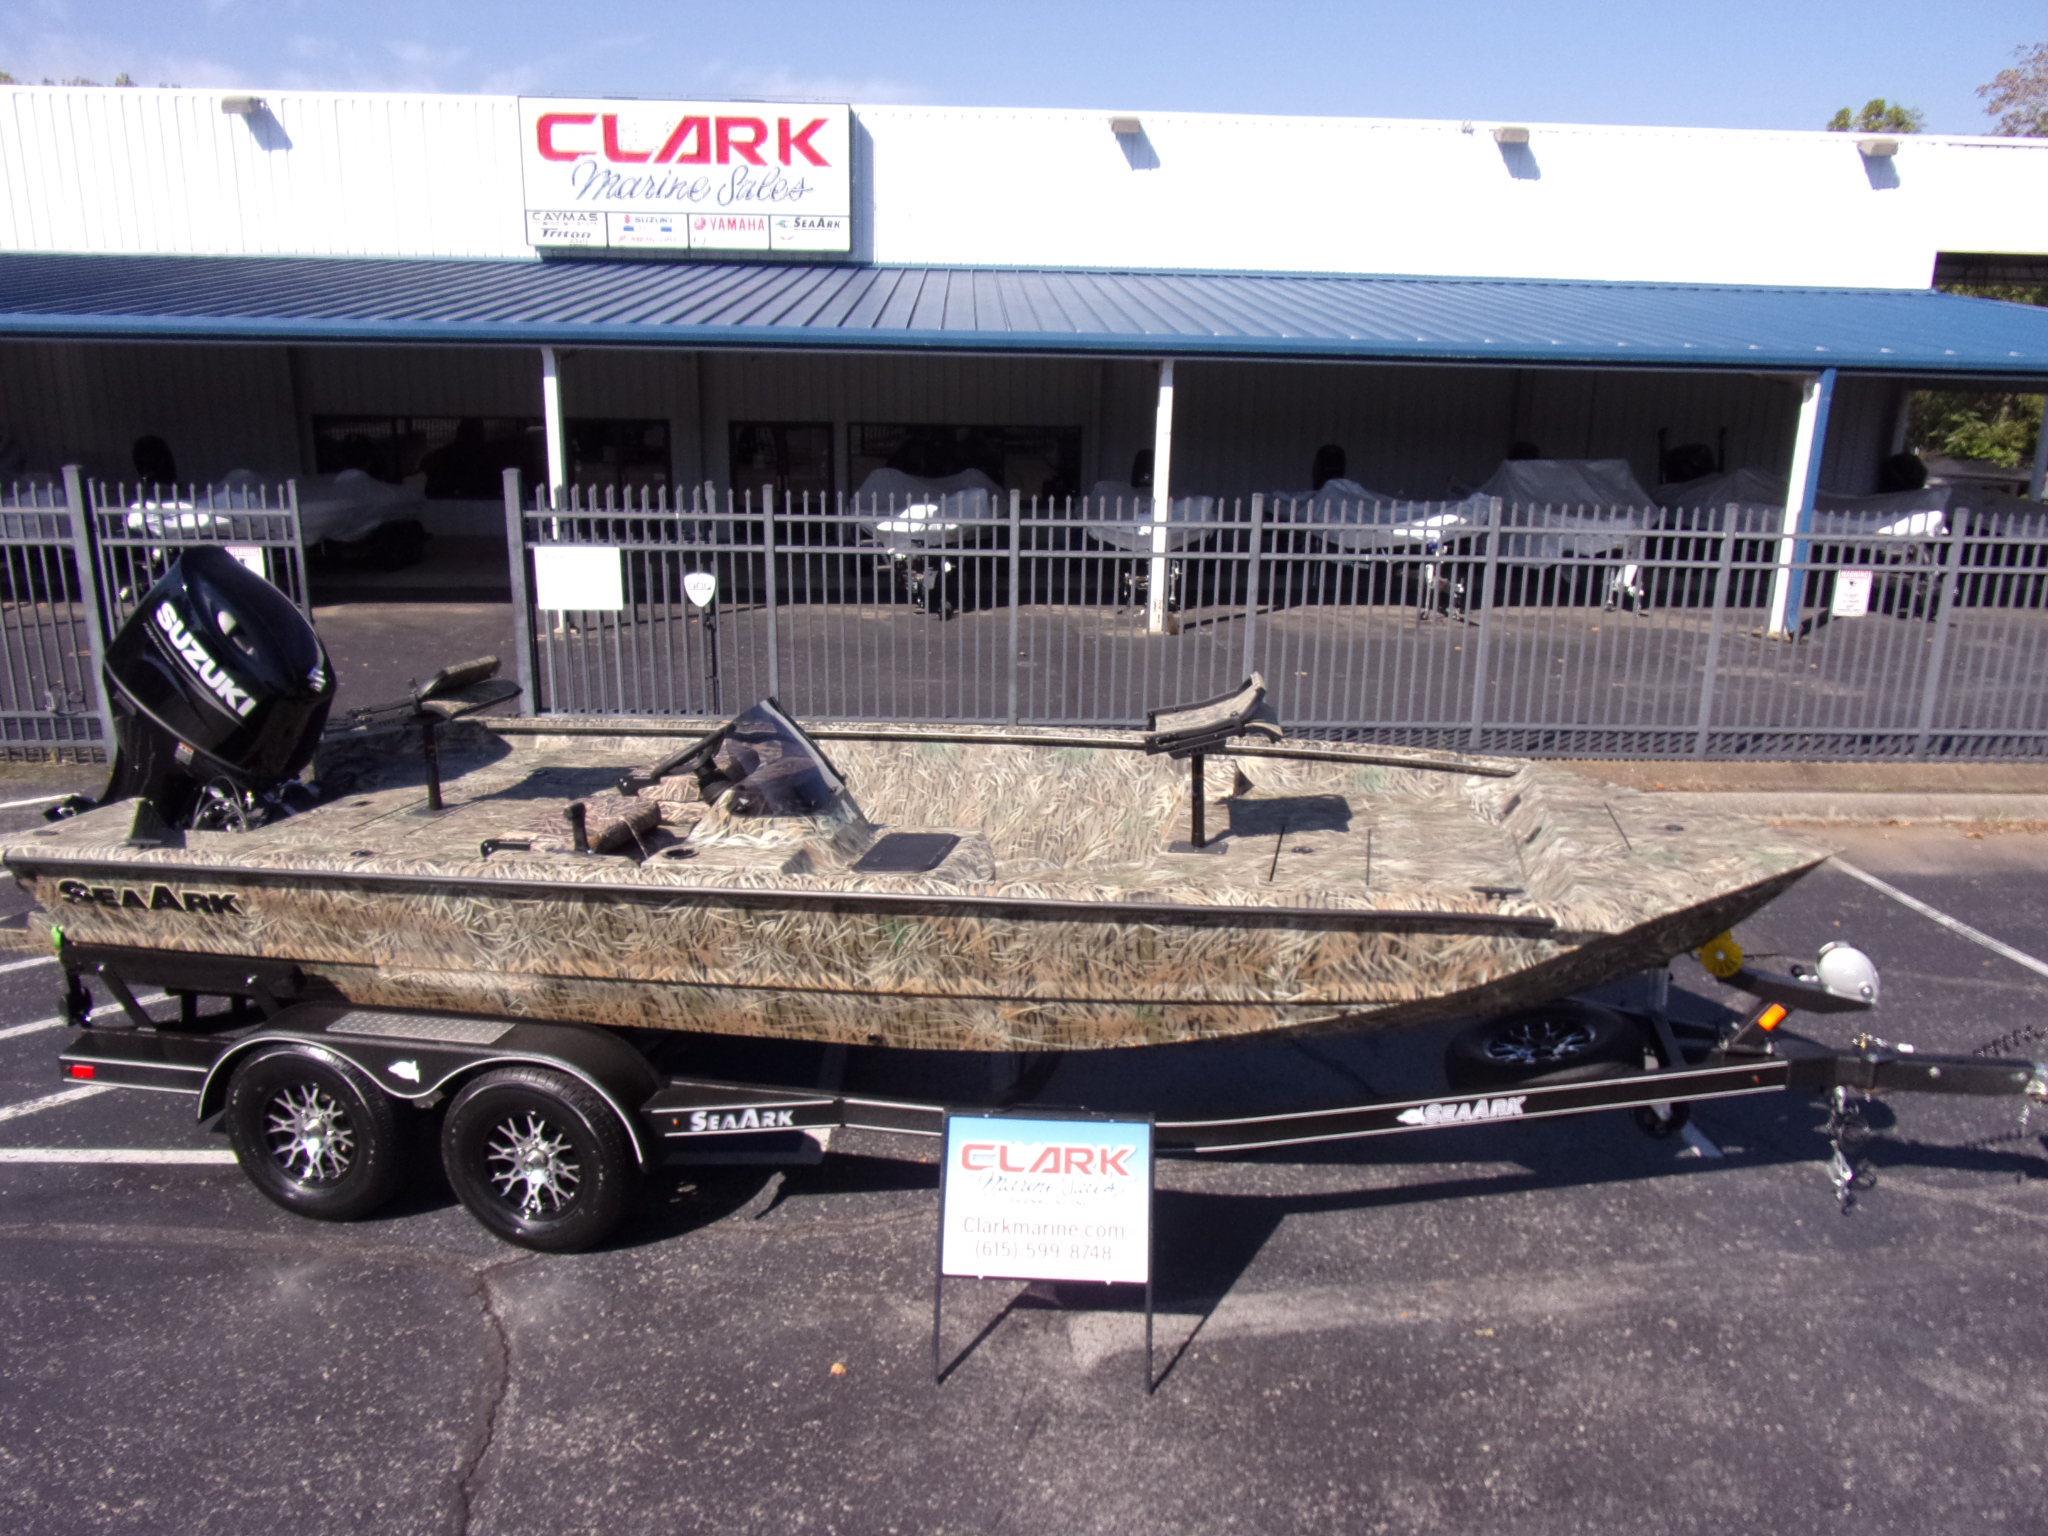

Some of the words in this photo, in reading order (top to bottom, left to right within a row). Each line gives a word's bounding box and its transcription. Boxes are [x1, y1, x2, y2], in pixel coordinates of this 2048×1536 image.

[536, 111, 832, 167] CLARK
[571, 159, 711, 201] Marine
[717, 164, 814, 207] Sales
[532, 212, 598, 222] CAYMAS
[710, 217, 765, 231] YAMAHA
[541, 228, 591, 239] Triton
[156, 602, 257, 717] SUZUKI
[961, 1143, 1130, 1176] CLARK
[963, 1216, 1126, 1239] Clarkmarine.com
[975, 1239, 1018, 1261] (615)
[1026, 1243, 1060, 1259] 599
[1069, 1245, 1112, 1262] 8748
